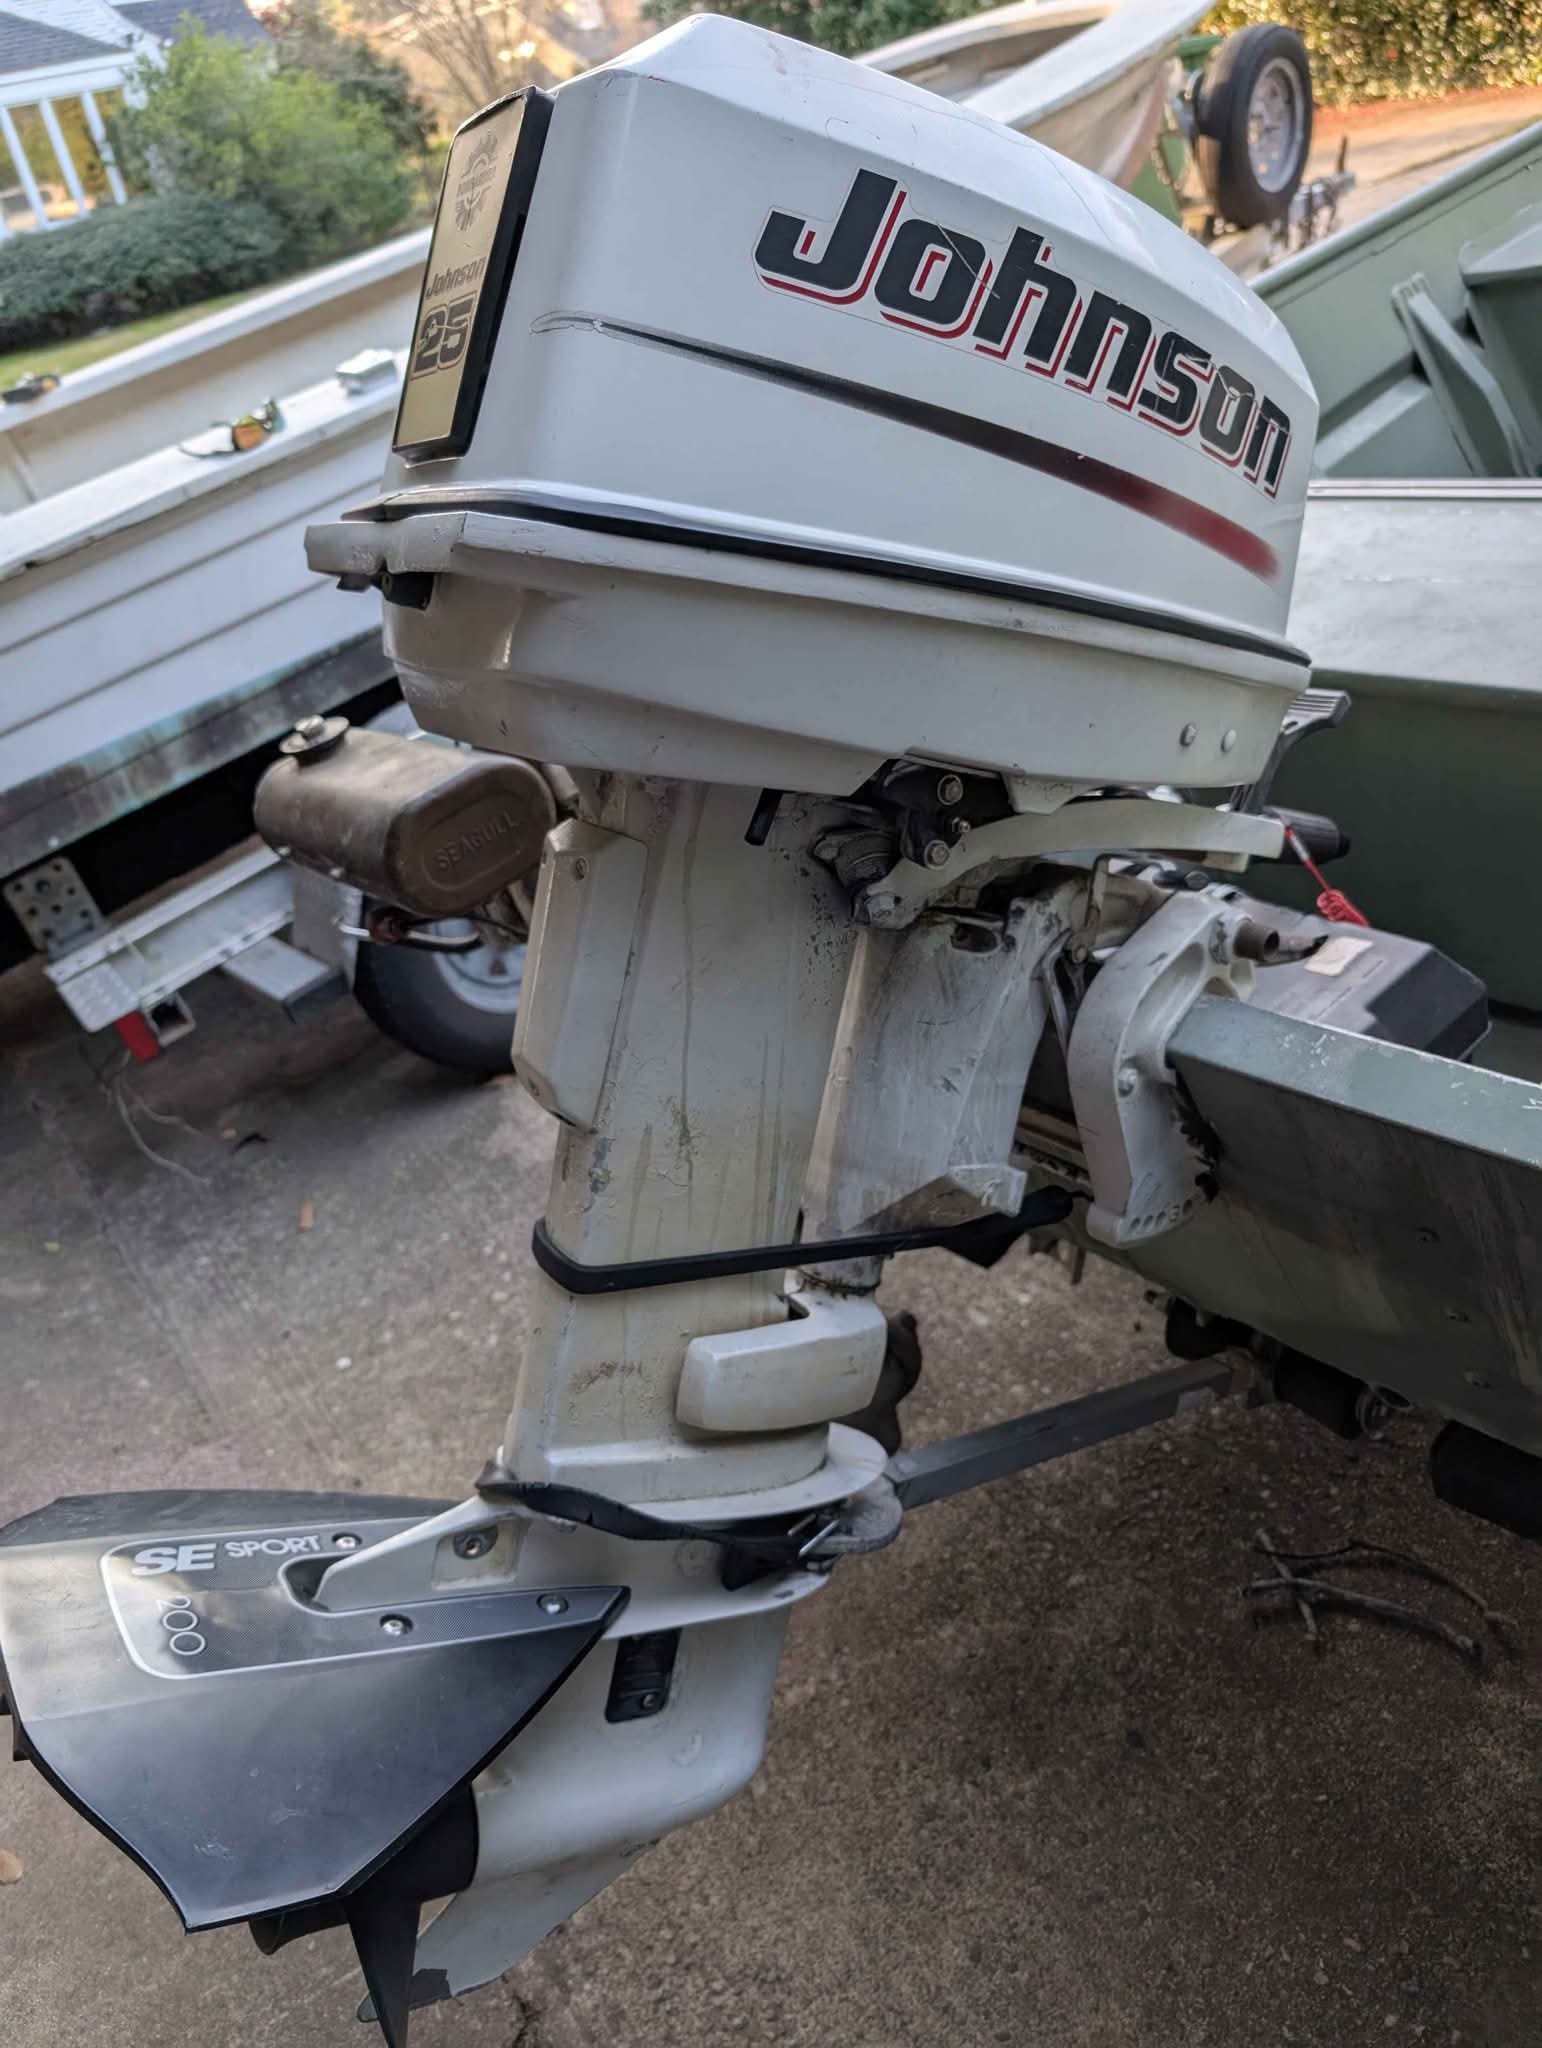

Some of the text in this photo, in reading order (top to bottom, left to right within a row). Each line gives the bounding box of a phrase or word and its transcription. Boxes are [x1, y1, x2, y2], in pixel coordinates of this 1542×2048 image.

[425, 256, 487, 299] Johnson
[411, 290, 477, 380] 25
[755, 167, 1293, 498] Johnson
[432, 809, 520, 872] SEAGULL
[131, 1534, 321, 1576] SE SPORT
[155, 1594, 206, 1656] 200
